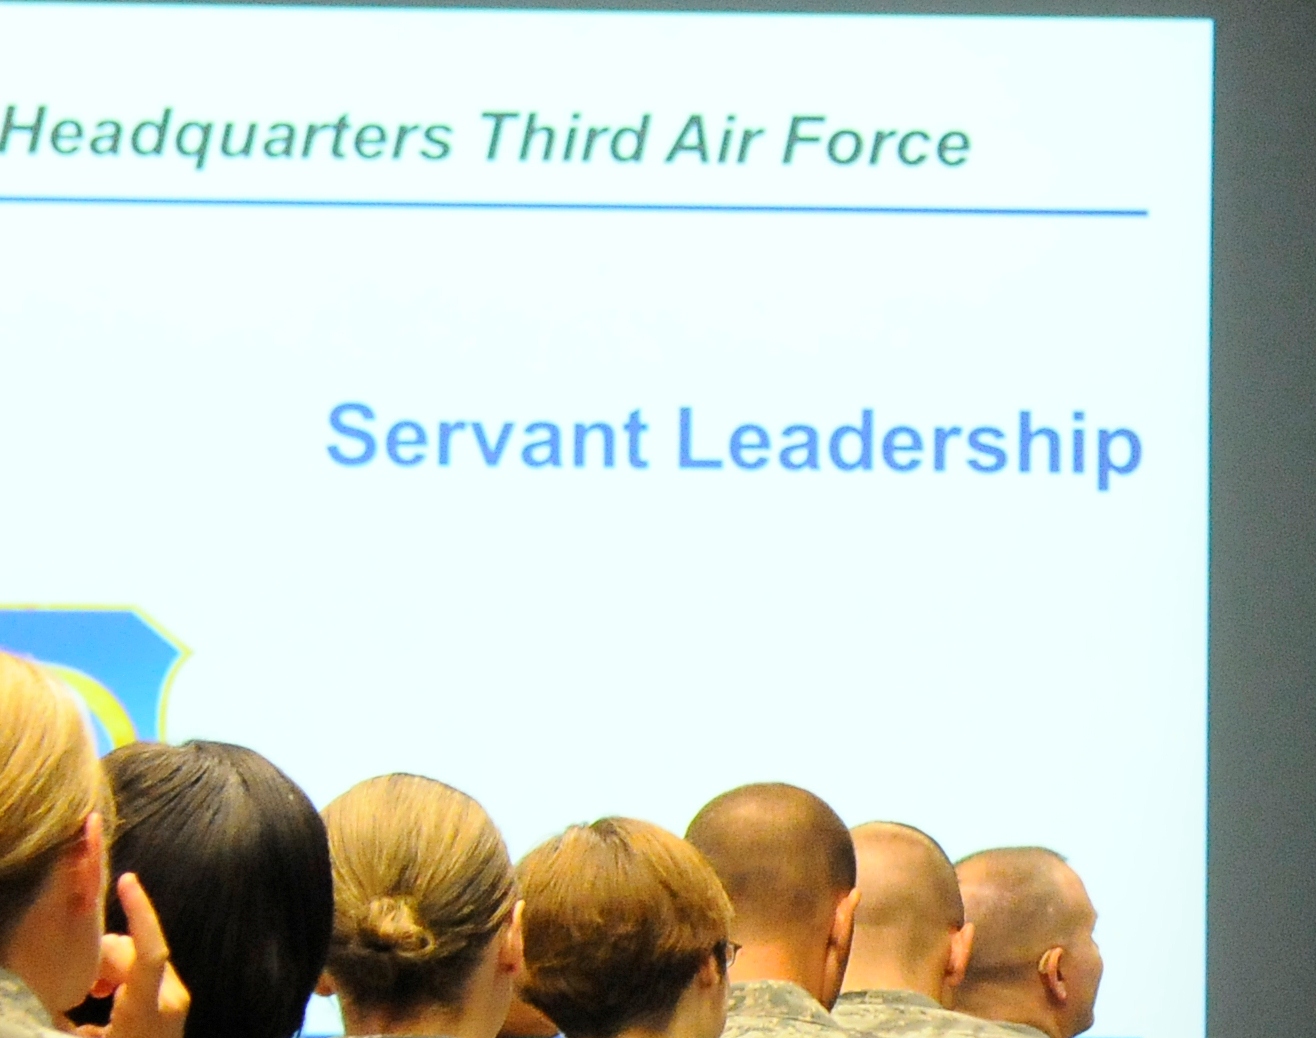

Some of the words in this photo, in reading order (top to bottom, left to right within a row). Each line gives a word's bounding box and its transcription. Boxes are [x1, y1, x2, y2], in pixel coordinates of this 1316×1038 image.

[0, 104, 454, 172] Headquarters
[480, 110, 652, 164] Third
[664, 113, 766, 165] Air
[781, 114, 972, 169] Force
[325, 400, 652, 471] Servant
[677, 405, 1144, 494] Leadership
